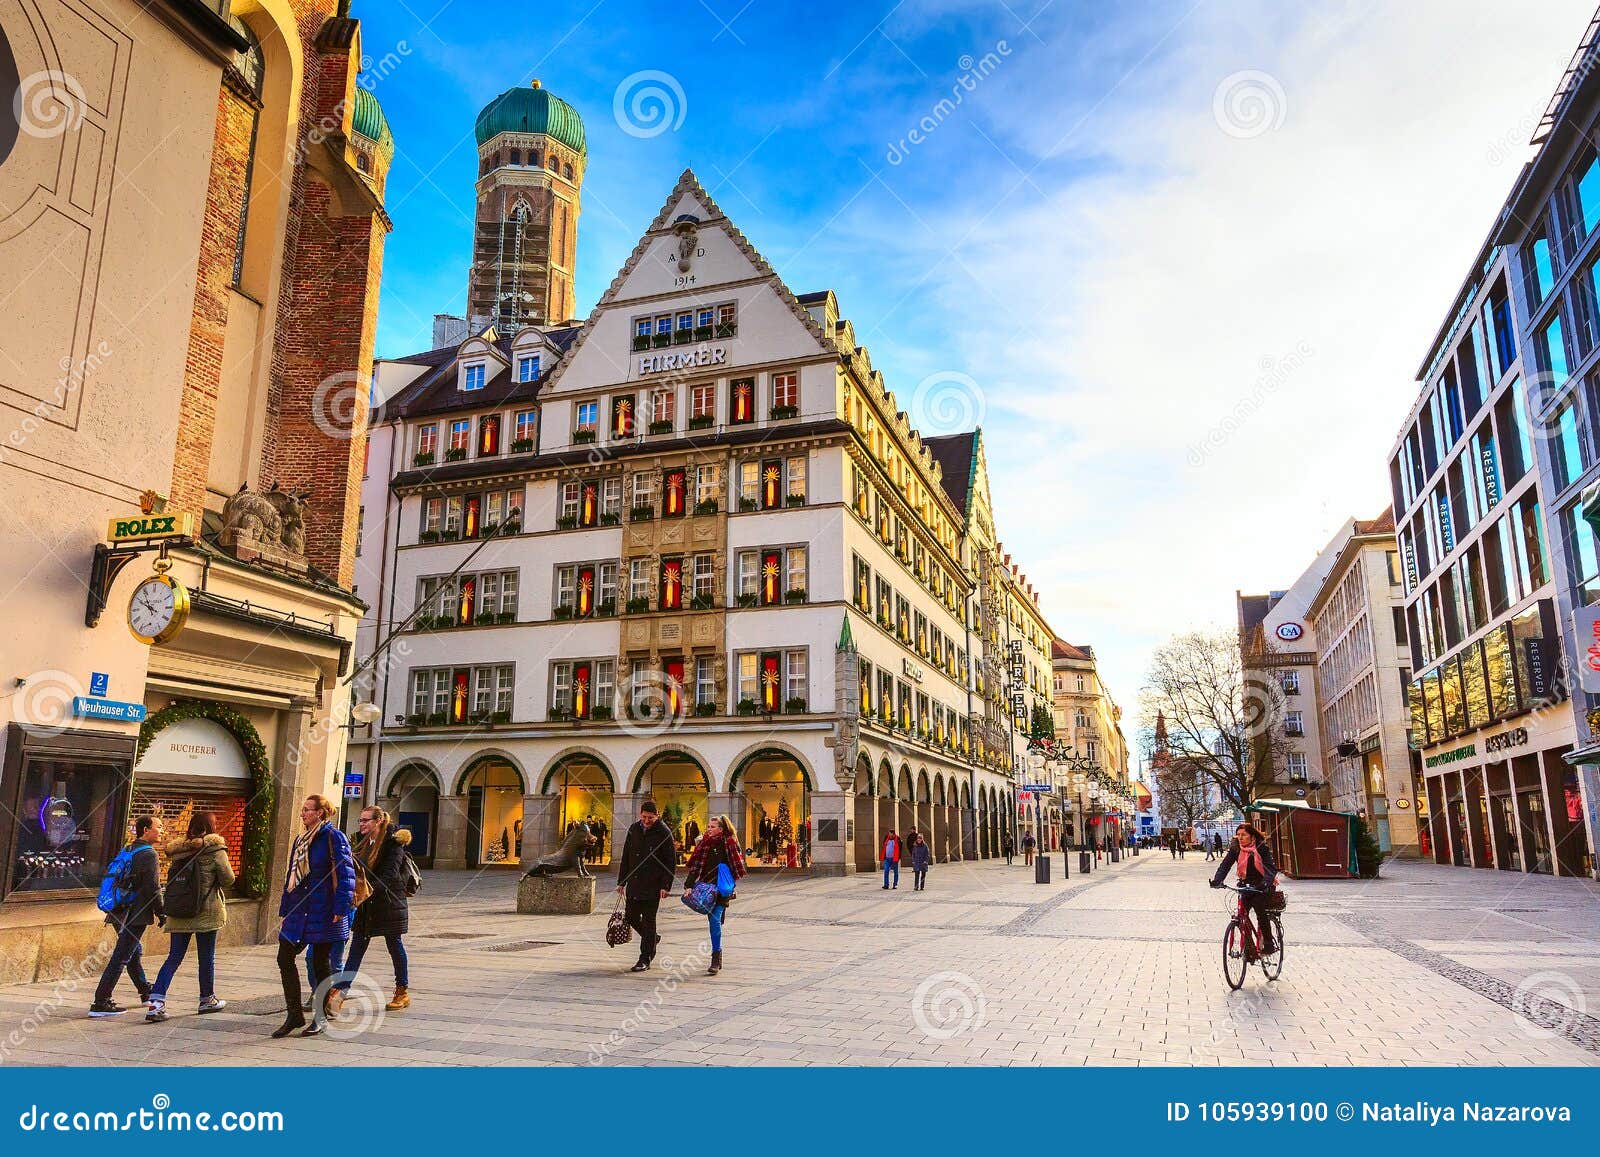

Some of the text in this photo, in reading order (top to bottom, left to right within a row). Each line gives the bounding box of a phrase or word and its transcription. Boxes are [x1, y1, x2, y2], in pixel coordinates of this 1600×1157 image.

[675, 275, 697, 287] 1914
[639, 346, 727, 375] HIRMER
[115, 516, 176, 537] ROLEX
[1440, 503, 1453, 555] RESERVE
[1281, 627, 1298, 636] C&A
[1531, 642, 1544, 693] RESERVED
[96, 675, 104, 686] 2
[1012, 641, 1026, 718] HIRMER
[78, 699, 141, 719] Neuhauser Str.
[170, 743, 217, 756] BUCHERER
